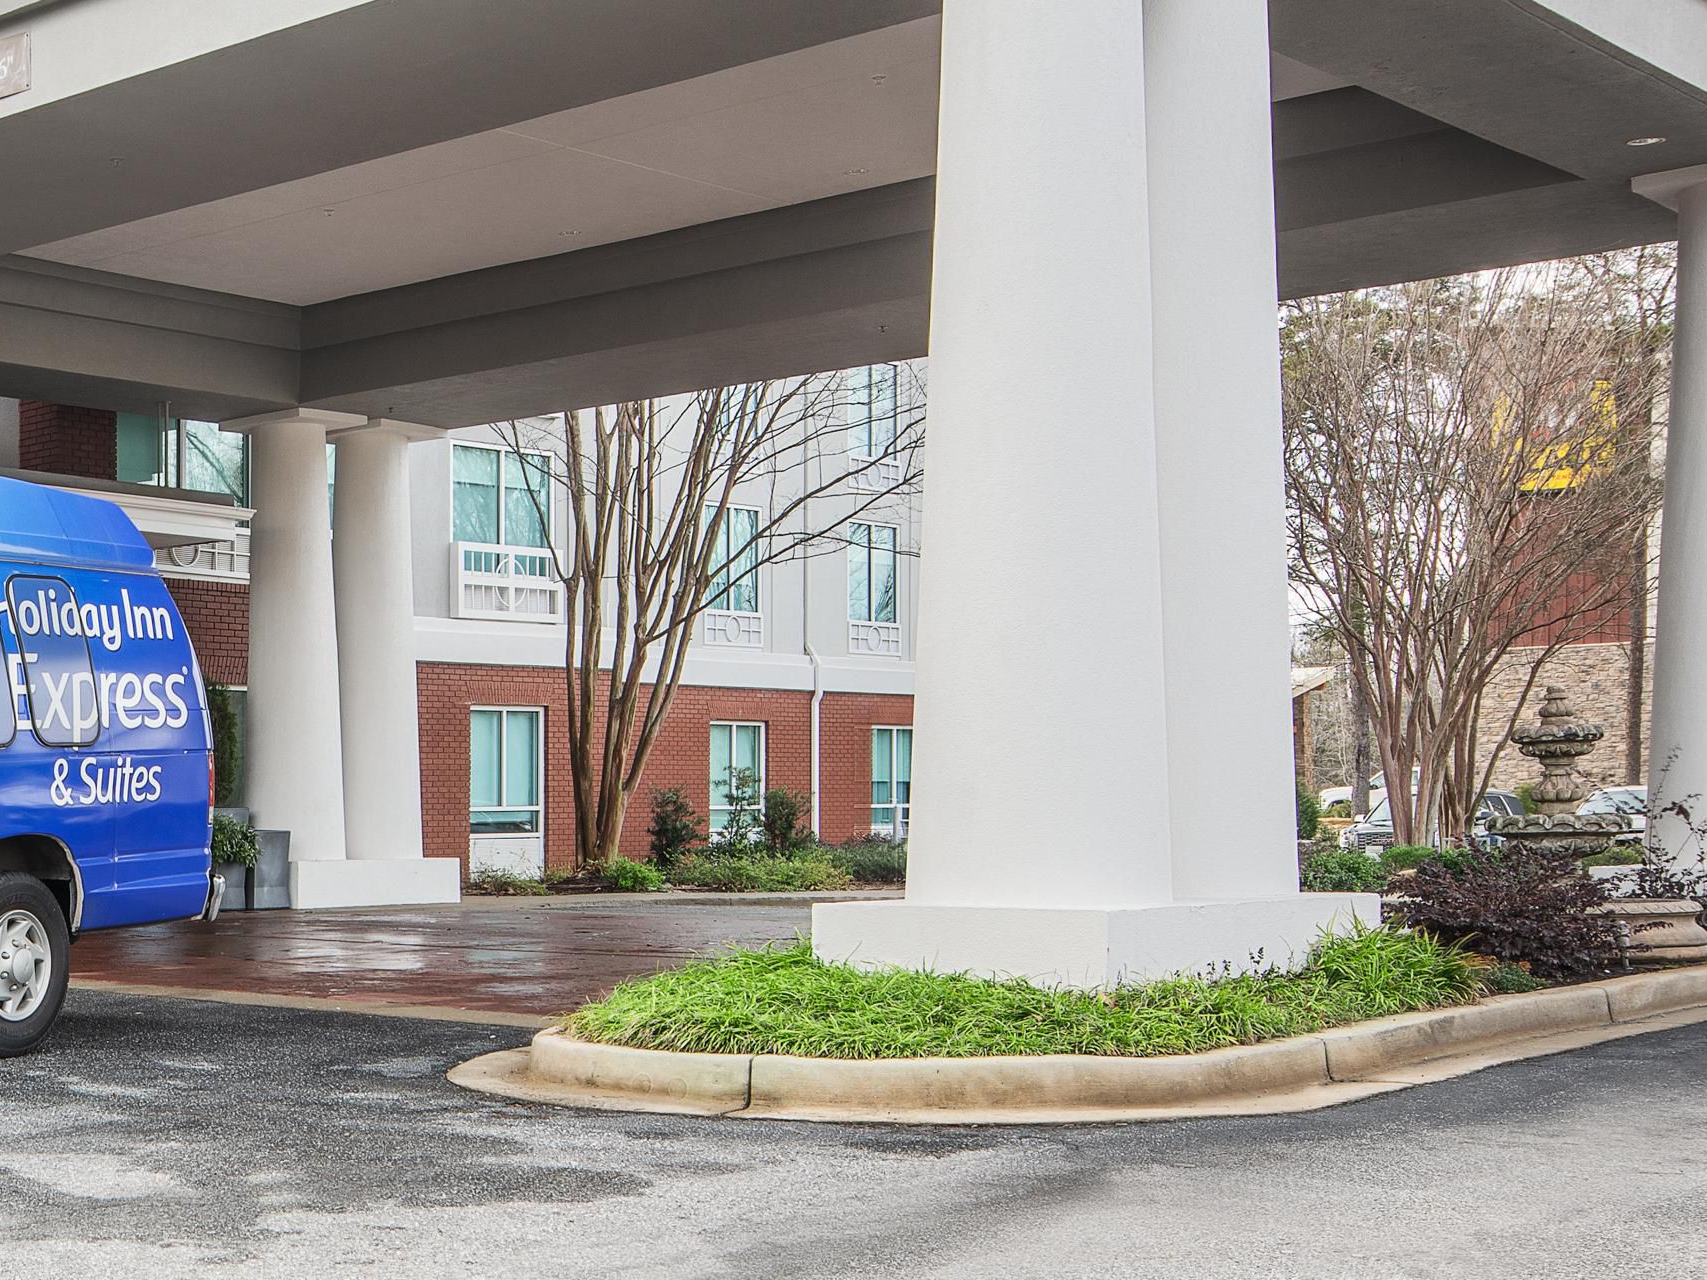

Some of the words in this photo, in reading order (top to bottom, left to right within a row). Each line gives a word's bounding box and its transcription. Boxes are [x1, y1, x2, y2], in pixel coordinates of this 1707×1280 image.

[121, 588, 174, 641] Inn
[50, 757, 74, 807] &
[79, 756, 162, 805] Suites
